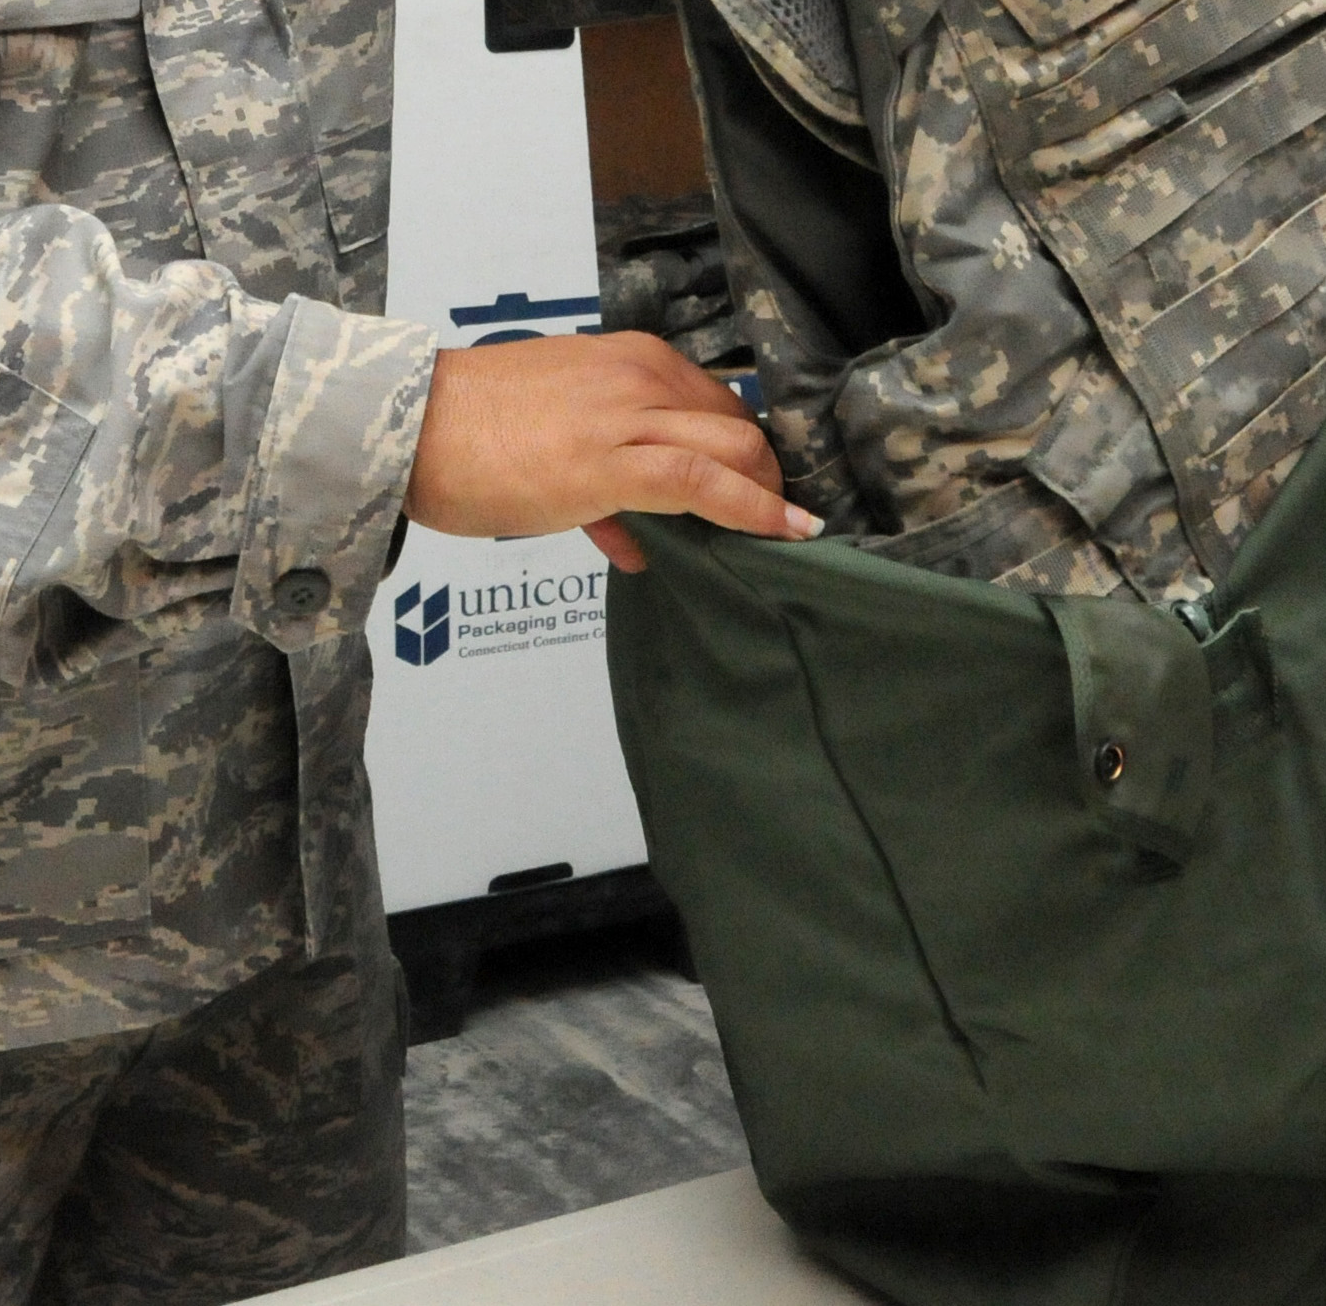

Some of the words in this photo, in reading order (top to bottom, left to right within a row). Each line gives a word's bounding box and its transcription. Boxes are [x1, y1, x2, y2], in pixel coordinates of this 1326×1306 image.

[458, 569, 608, 617] unicor
[458, 615, 557, 640] Packaging
[563, 609, 607, 625] Grou
[458, 639, 530, 659] Connecticut
[533, 631, 589, 648] Container
